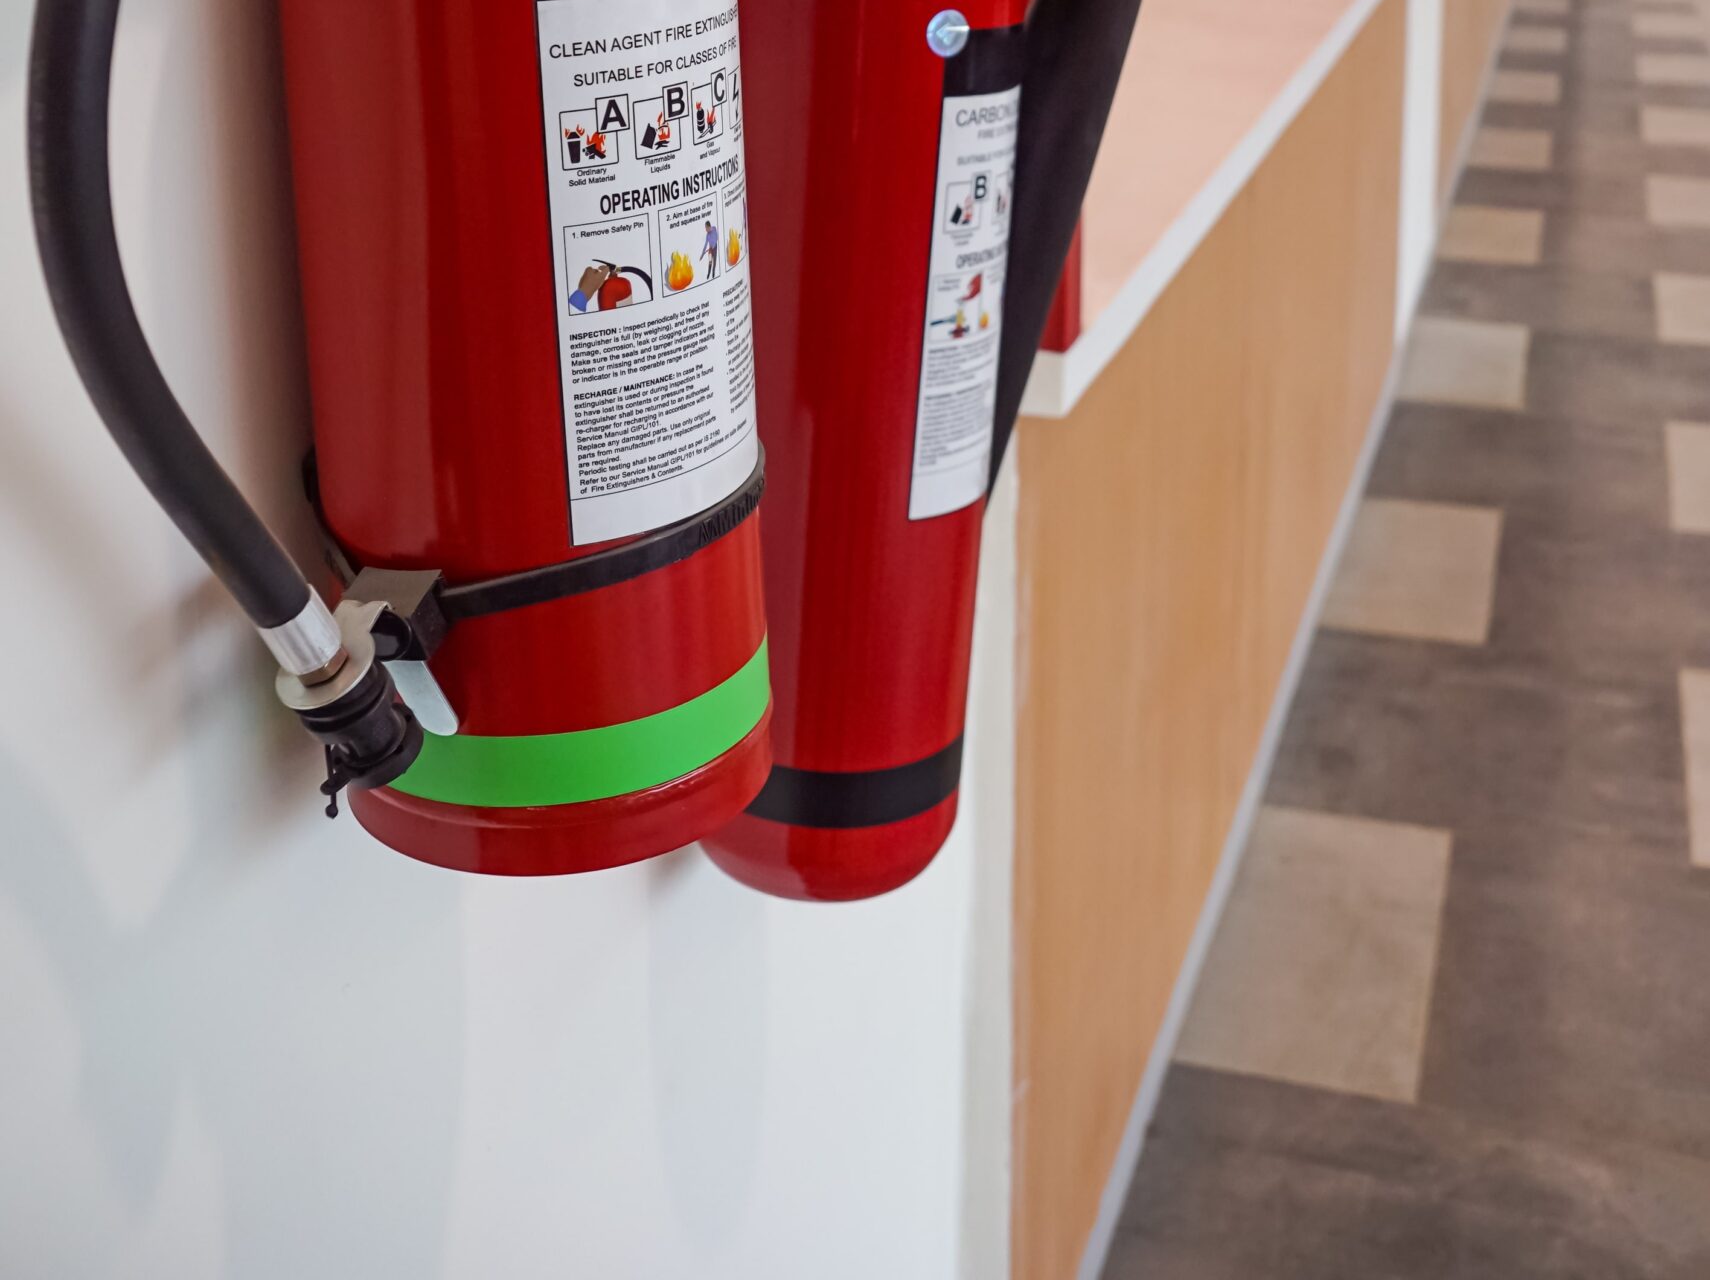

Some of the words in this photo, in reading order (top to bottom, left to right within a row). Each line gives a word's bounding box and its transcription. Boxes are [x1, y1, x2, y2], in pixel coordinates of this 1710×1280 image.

[550, 40, 606, 59] CLEAN
[610, 30, 662, 52] AGENT
[666, 24, 692, 42] FIRE
[696, 3, 738, 35] EXTINGUISHE
[574, 64, 643, 86] SUITABLE
[648, 60, 673, 76] FOR
[676, 48, 718, 70] CLASSES
[718, 42, 727, 56] OF
[714, 73, 724, 102] C
[666, 87, 685, 118] B
[600, 100, 627, 130] A
[644, 154, 676, 165] Flammable
[577, 168, 606, 177] Ordinary
[651, 164, 670, 174] Liquids
[568, 178, 586, 187] Solid
[588, 174, 616, 184] Material
[600, 180, 680, 215] OPERATING
[682, 154, 739, 198] INSTRUCTIONS
[974, 176, 987, 200] B
[672, 211, 682, 220] Aim
[690, 206, 702, 214] base
[670, 221, 680, 229] and
[681, 214, 700, 226] squeeze
[580, 228, 609, 238] Remove
[611, 224, 632, 234] Safety
[569, 327, 616, 340] INSPECTION
[622, 321, 645, 331] Inspect
[570, 338, 611, 349] extinguisher
[570, 349, 601, 358] damage,
[602, 342, 635, 353] corrosion,
[621, 349, 638, 358] seals
[606, 360, 631, 369] missing
[633, 356, 645, 364] and
[581, 373, 610, 382] indicator
[573, 387, 617, 400] RECHARGE
[574, 397, 615, 409] extinguisher
[624, 391, 640, 400] used
[575, 414, 616, 426] extinguisher
[618, 409, 633, 418] shall
[576, 424, 611, 434] re-charger
[576, 434, 602, 442] Service
[604, 427, 628, 438] Manual
[577, 442, 605, 451] Replace
[577, 452, 595, 460] parts
[591, 455, 620, 465] required.
[578, 466, 606, 476] Periodic
[608, 462, 630, 471] testing
[632, 457, 646, 466] shall
[621, 468, 645, 478] Service
[606, 475, 649, 489] Extinguishers
